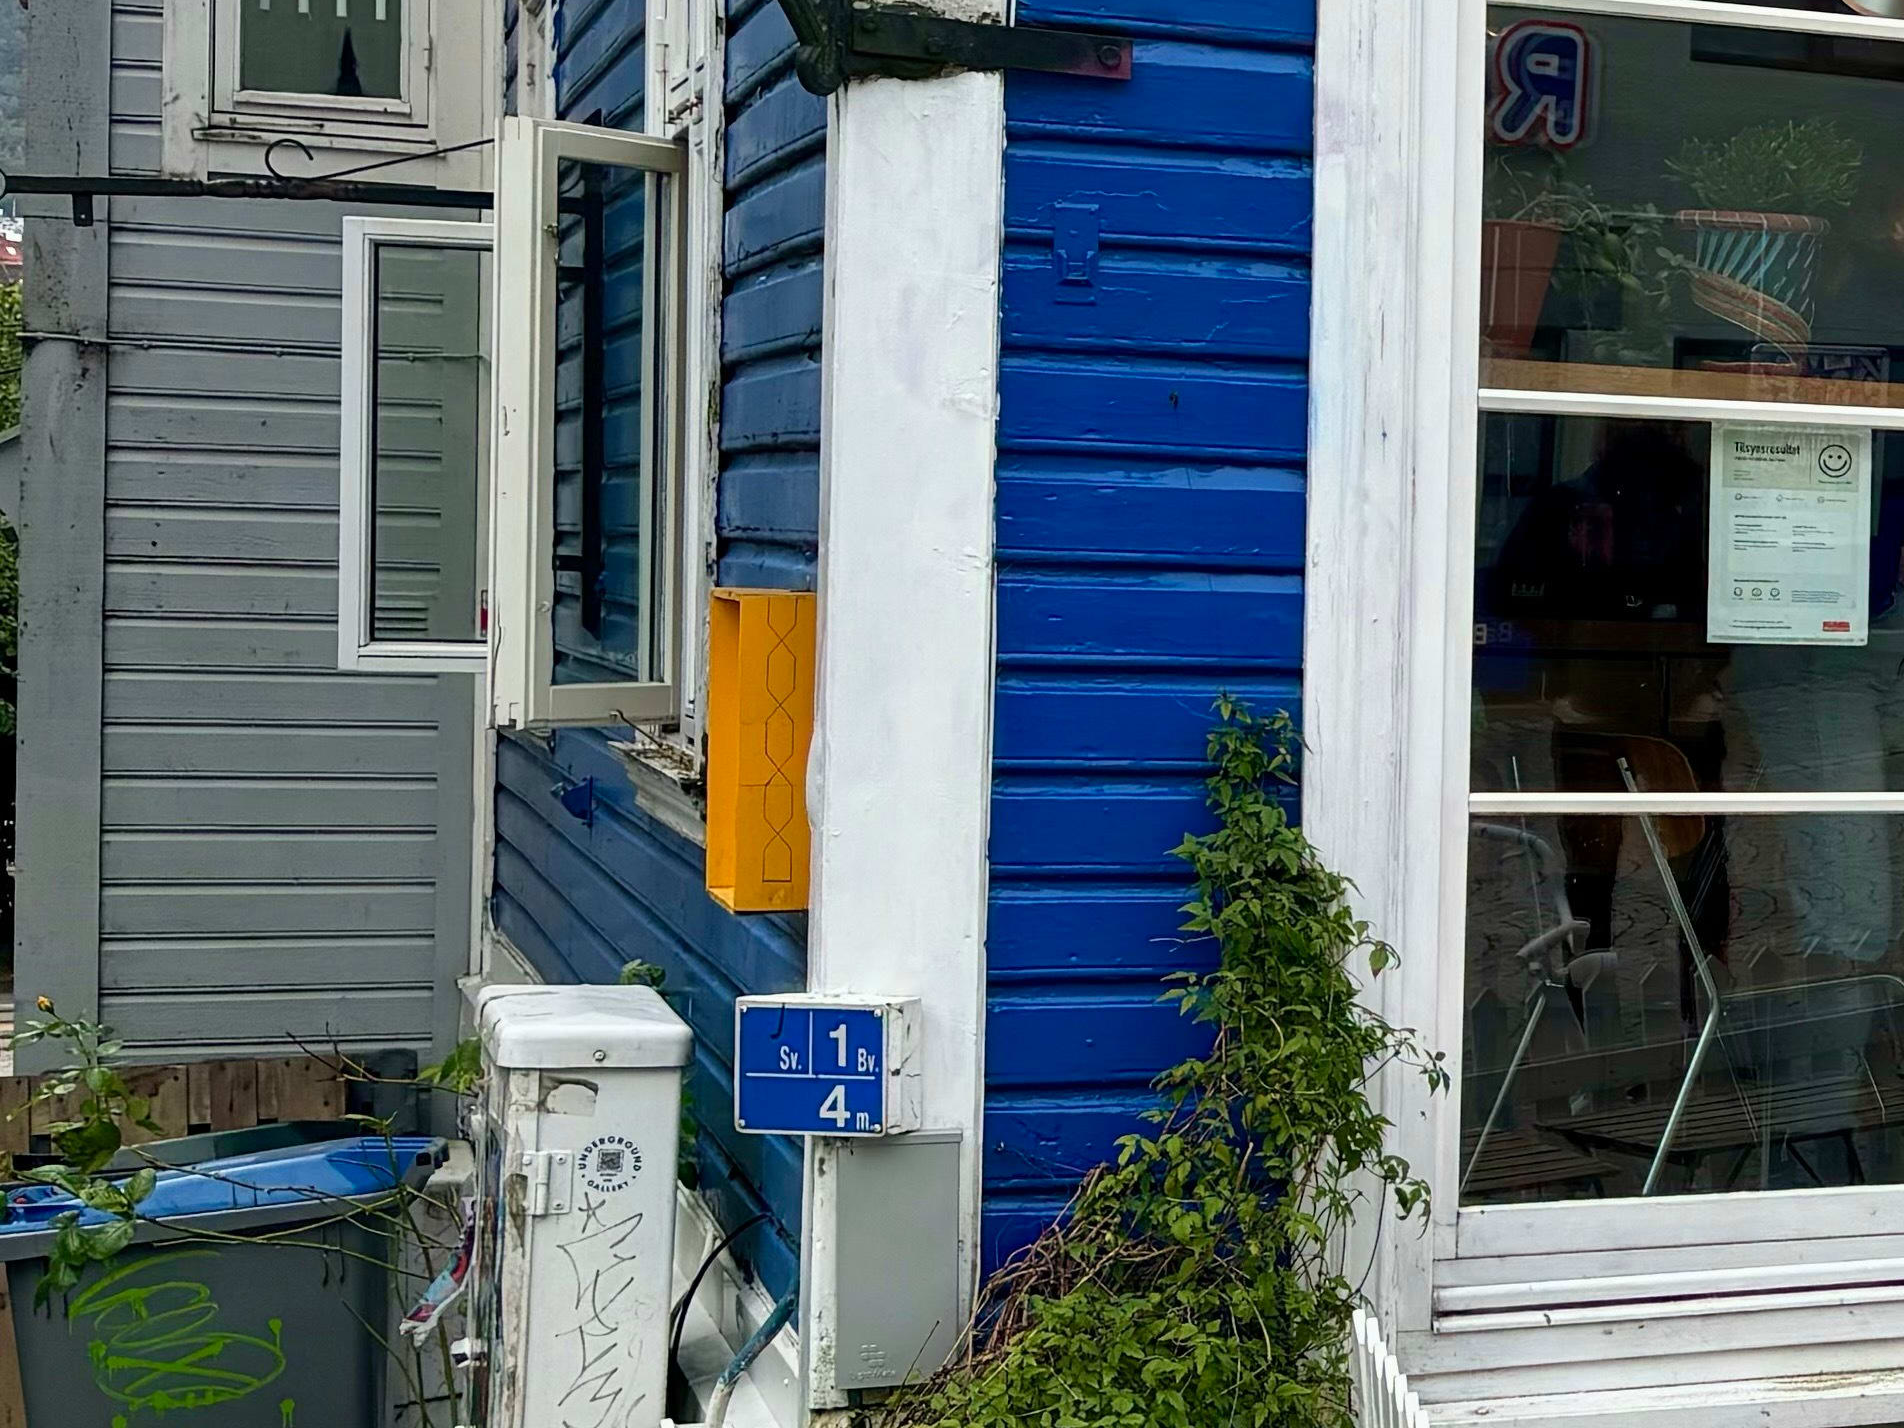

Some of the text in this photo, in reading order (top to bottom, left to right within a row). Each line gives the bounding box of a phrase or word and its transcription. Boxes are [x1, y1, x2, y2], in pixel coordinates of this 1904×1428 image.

[779, 1045, 803, 1071] Sv.
[829, 1023, 880, 1073] 1 Bv.
[818, 1084, 851, 1128] 4
[578, 1135, 642, 1172] UNDERGROUND
